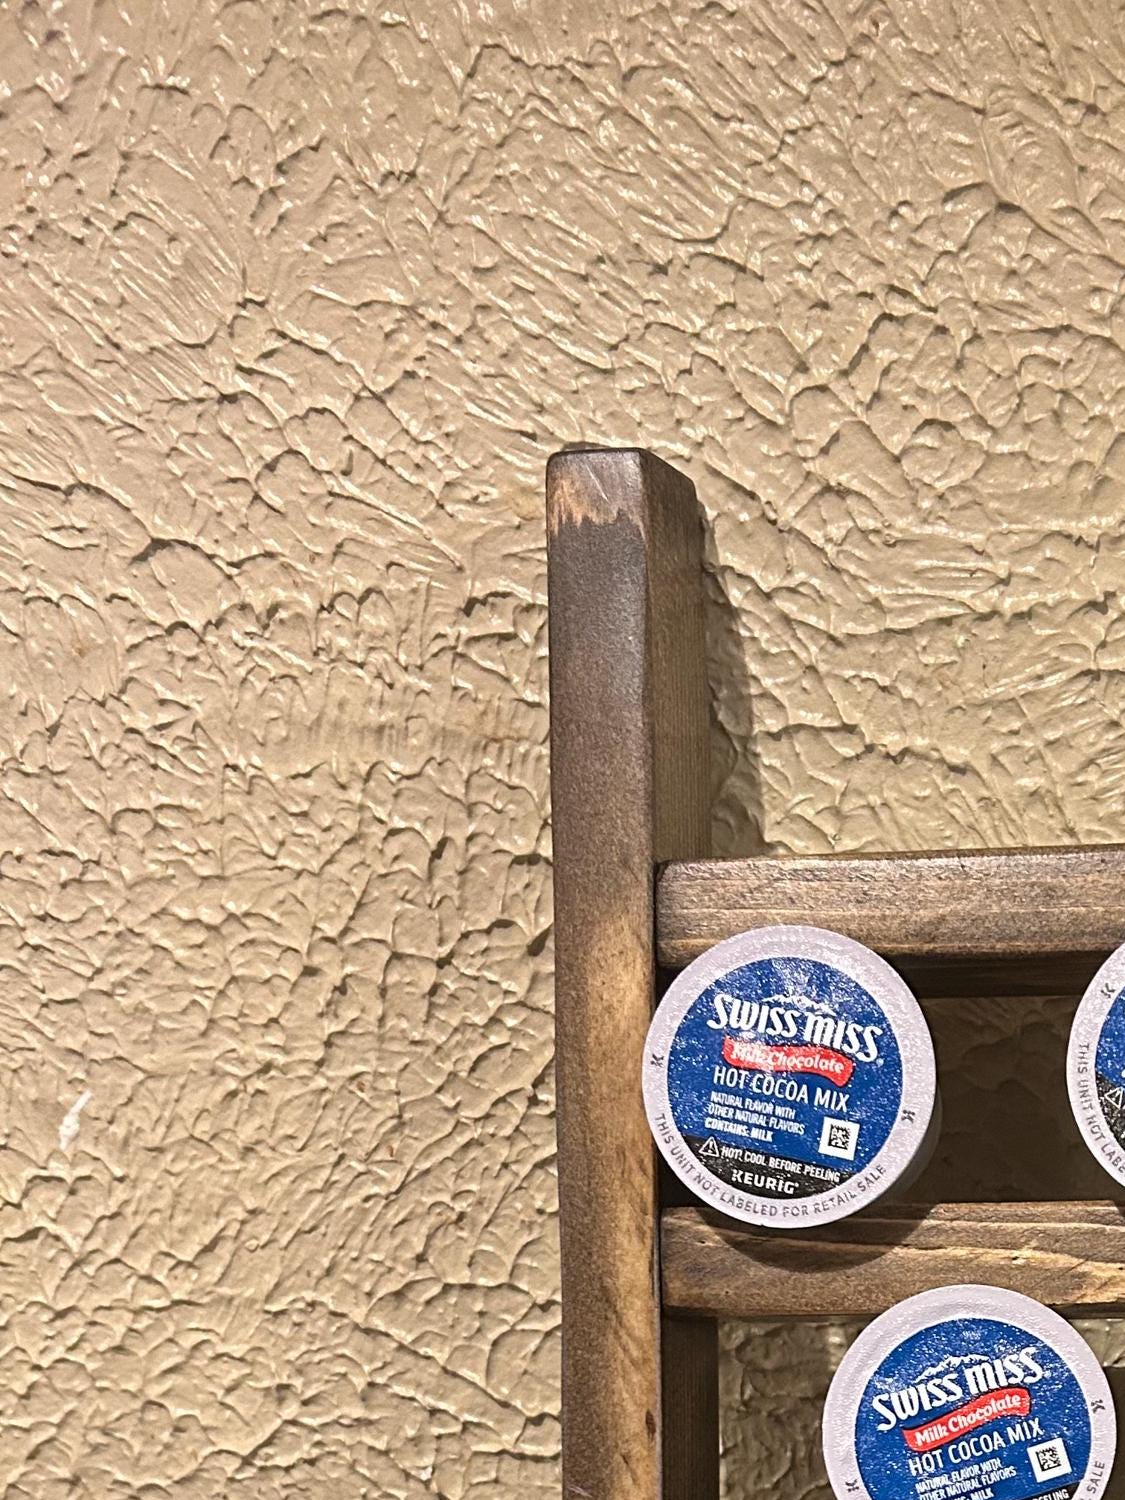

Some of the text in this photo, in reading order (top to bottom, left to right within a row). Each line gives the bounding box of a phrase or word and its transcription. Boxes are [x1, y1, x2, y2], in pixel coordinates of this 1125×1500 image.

[766, 1053, 845, 1075] Chocolate
[1078, 1041, 1089, 1074] THIS
[711, 1064, 850, 1112] HOT COCOA MIX
[1078, 1078, 1093, 1110] UNIT
[750, 1127, 775, 1142] MILK
[1085, 1114, 1103, 1142] NOT
[655, 1112, 887, 1220] THIS UNIT NOT LABELED FOR RETAIL SALE
[719, 1146, 840, 1183] HOT! COOL BEFORE PEELING
[870, 1371, 961, 1431] SWISS
[914, 1393, 1023, 1448] Milk Chocolate
[906, 1417, 1044, 1477] HOT COCOA MIX
[914, 1456, 1002, 1494] NATURAL FLAVOR WITH
[945, 1477, 982, 1497] NATURAL
[980, 1464, 1017, 1486] FLAVORS
[1084, 1458, 1104, 1494] SALE
